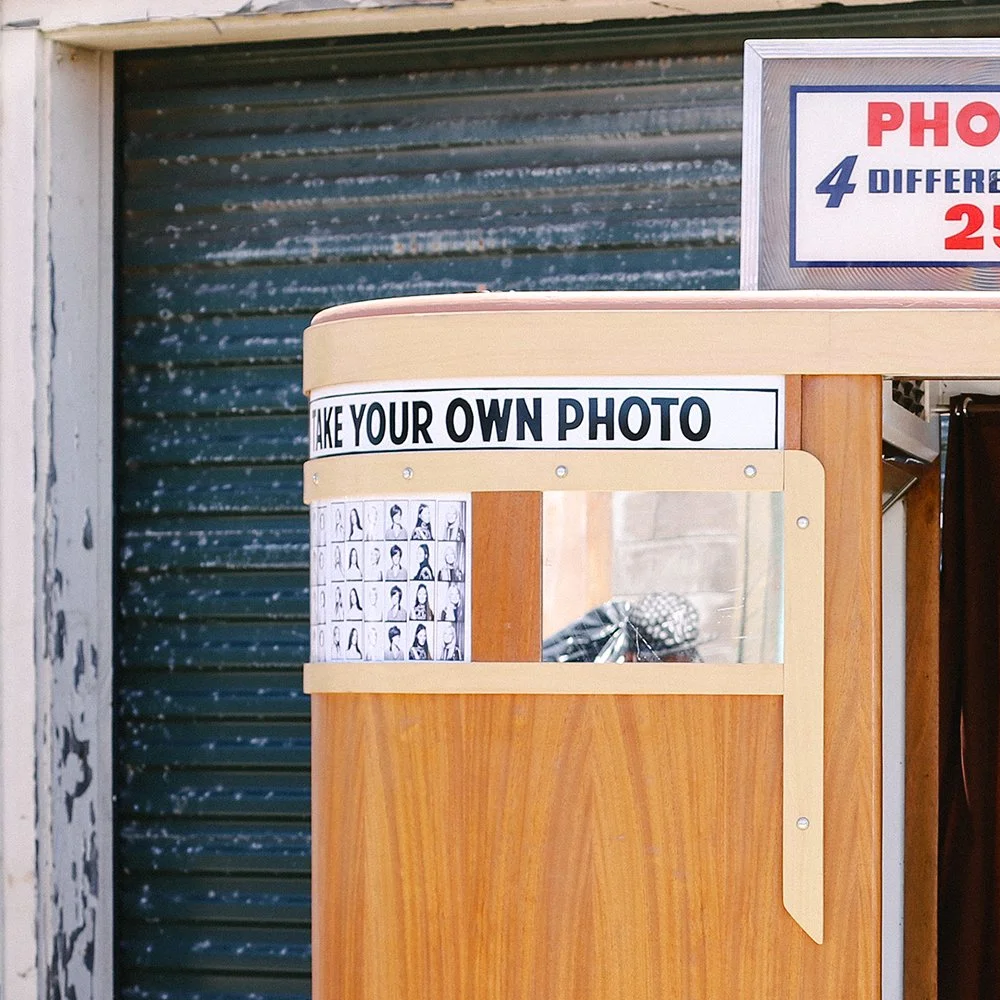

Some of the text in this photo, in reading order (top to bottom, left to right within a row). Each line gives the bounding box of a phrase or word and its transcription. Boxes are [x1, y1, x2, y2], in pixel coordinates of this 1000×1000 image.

[815, 154, 859, 209] 4
[349, 401, 434, 447] YOUR
[445, 397, 543, 443] OWN
[557, 396, 712, 442] PHOTO
